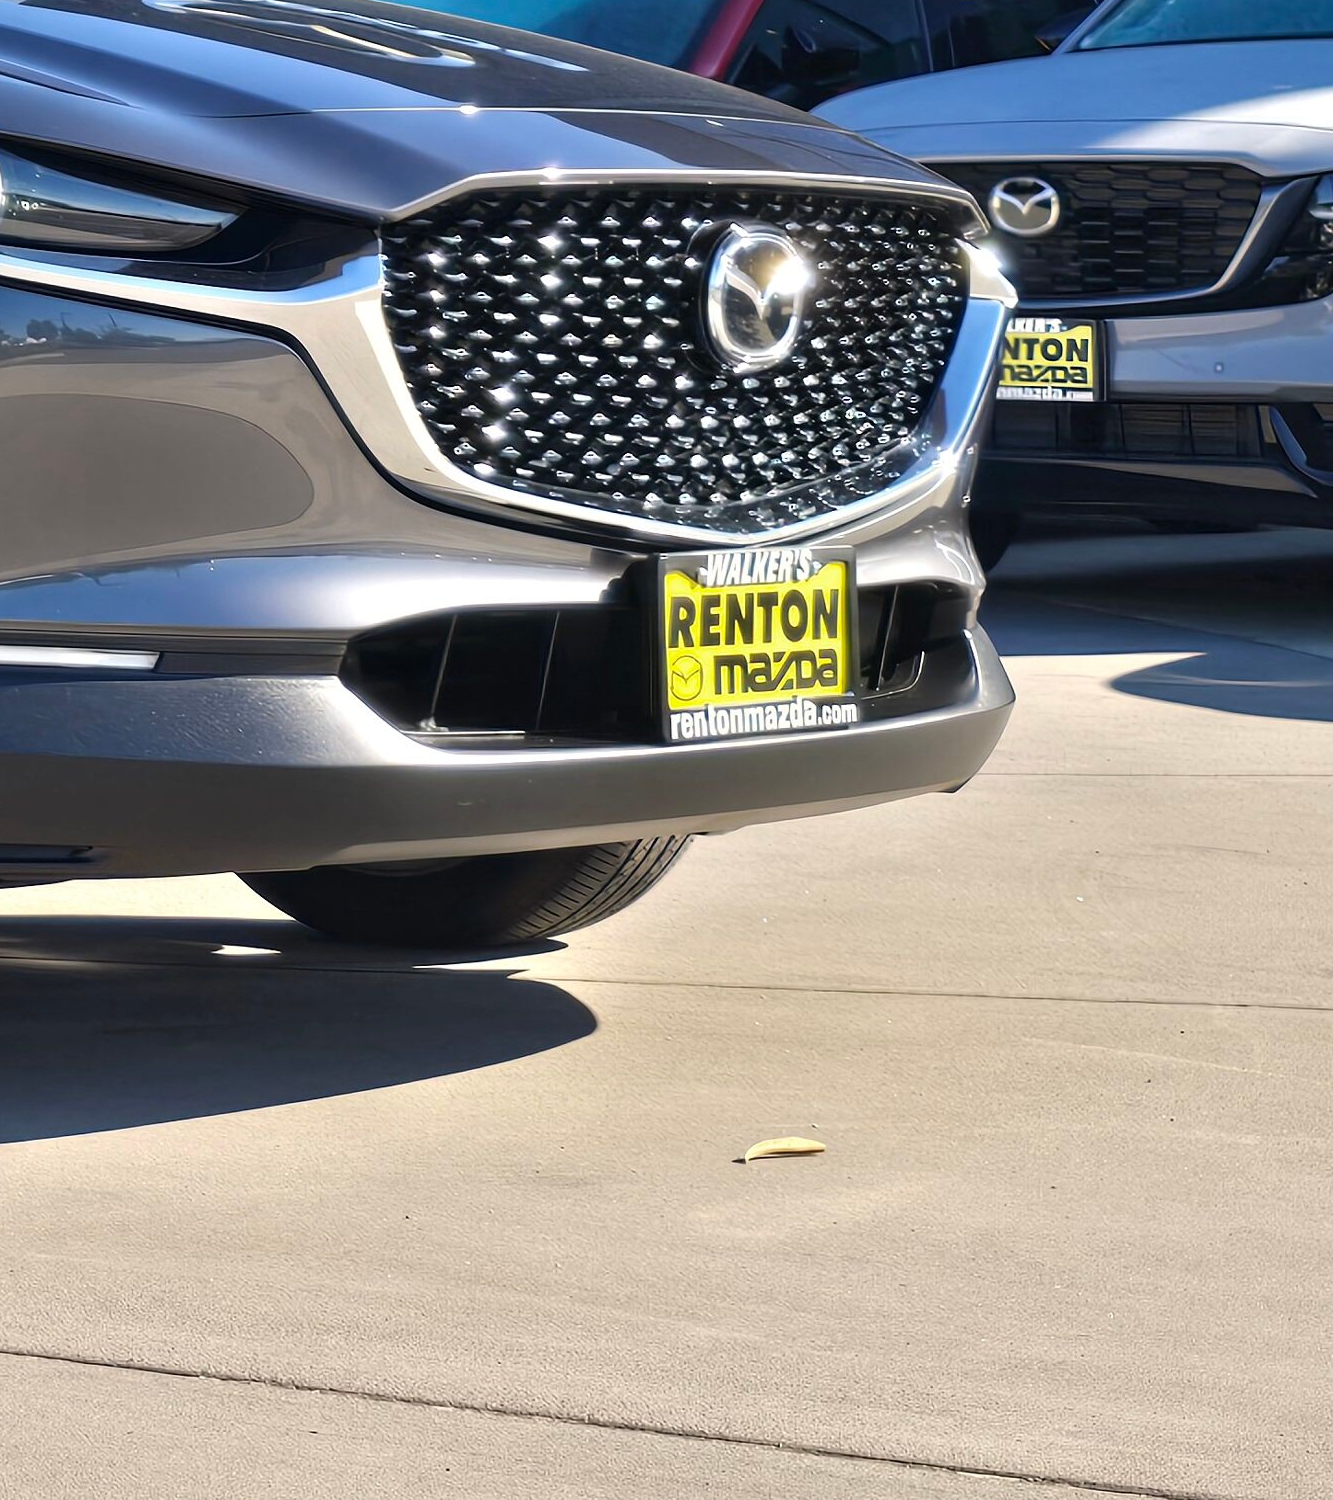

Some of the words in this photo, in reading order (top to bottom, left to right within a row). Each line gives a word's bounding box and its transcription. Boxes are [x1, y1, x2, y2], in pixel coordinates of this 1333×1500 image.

[1004, 338, 1089, 362] NTON
[706, 550, 814, 587] WALKER'S
[668, 588, 840, 648] RENTON
[669, 696, 858, 740] rentonmazda.com
